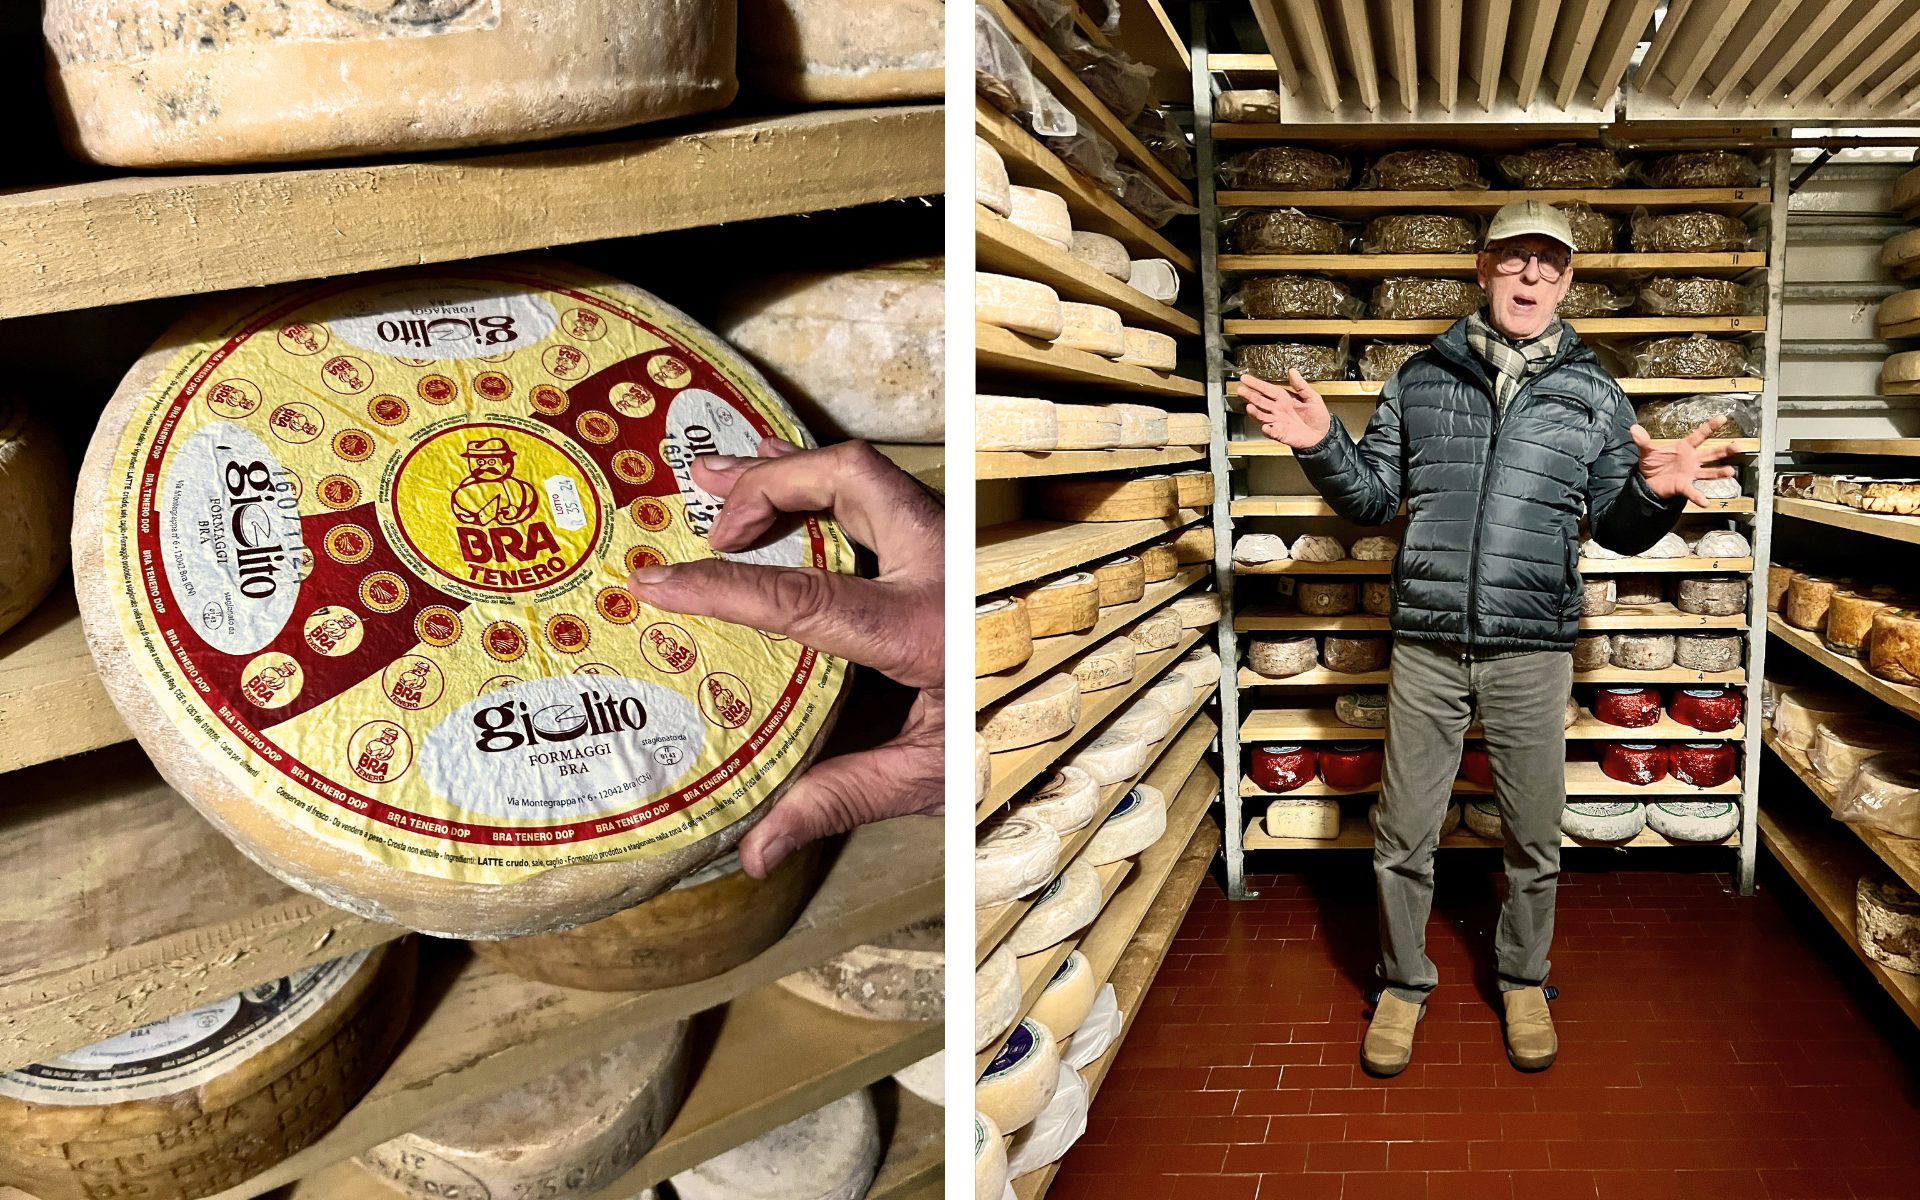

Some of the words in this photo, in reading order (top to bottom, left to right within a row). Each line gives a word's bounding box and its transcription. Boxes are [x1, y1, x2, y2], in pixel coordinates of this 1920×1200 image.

[1734, 190, 1744, 200] 12
[1732, 254, 1739, 265] 11
[376, 315, 519, 348] giolito
[1730, 318, 1740, 329] 10
[328, 358, 354, 377] BRA
[213, 384, 236, 404] BRA
[1731, 378, 1737, 388] 9
[170, 405, 182, 418] BRA
[276, 408, 298, 428] BRA
[157, 418, 175, 445] TENERO
[152, 443, 163, 459] DOP
[144, 473, 155, 487] BRA
[559, 480, 573, 491] 24
[141, 488, 152, 518] TENERO
[551, 493, 564, 515] LOTTO
[1719, 501, 1729, 509] 7
[140, 518, 150, 534] DOP
[198, 520, 210, 545] BRA
[210, 497, 228, 565] FORMAGGI
[225, 460, 285, 599] giolito
[456, 521, 561, 564] BRA
[142, 549, 153, 566] BRA
[1712, 561, 1719, 569] 6
[145, 566, 160, 597] TENERO
[179, 568, 188, 582] Bra
[467, 556, 567, 586] TENERO
[153, 597, 166, 614] DOP
[224, 591, 235, 627] stagionato
[124, 471, 134, 490] LATTE
[173, 688, 187, 702] CEE
[185, 703, 198, 717] 1263
[193, 714, 204, 725] del
[220, 741, 235, 757] Carta
[230, 753, 242, 763] per
[239, 759, 261, 778] alimenti
[228, 626, 235, 635] da
[309, 625, 337, 651] BRA
[165, 628, 179, 647] BRA
[174, 646, 198, 677] TENERO
[194, 675, 211, 694] DOP
[665, 645, 691, 668] BRA
[795, 669, 807, 685] BRA
[1697, 672, 1704, 682] 4
[242, 684, 265, 707] TENERO
[247, 674, 275, 703] BRA
[392, 682, 422, 701] BRA
[389, 693, 419, 709] TENERO
[721, 698, 747, 721] BRA
[473, 690, 648, 753] giolito
[750, 735, 766, 751] BRA
[761, 710, 784, 738] TENERO
[780, 696, 792, 713] DOP
[218, 705, 236, 724] BRA
[234, 719, 264, 751] TENERO
[263, 745, 283, 763] DOP
[641, 735, 677, 747] stagionato
[358, 752, 389, 776] BRA
[528, 743, 612, 767] FORMAGGI
[354, 765, 385, 782] TENERO
[559, 762, 589, 778] BRA
[682, 788, 701, 802] BRA
[698, 769, 728, 792] TENERO
[727, 758, 741, 773] DOP
[290, 765, 310, 783] BRA
[310, 776, 347, 802] TENERO
[347, 796, 369, 812] DOP
[507, 797, 520, 806] Via
[521, 796, 577, 809] Montegrappa
[587, 793, 594, 802] 6
[598, 786, 623, 799] 12042
[623, 780, 637, 791] Bra
[636, 772, 652, 786] (CN)
[276, 786, 306, 810] Conservare
[305, 803, 312, 813] al
[311, 806, 330, 822] fresco
[331, 817, 341, 828] Da
[340, 821, 364, 836] vendere
[368, 832, 384, 845] peso
[386, 839, 407, 851] Crosta
[407, 844, 419, 854] non
[419, 847, 440, 860] edibile
[443, 852, 477, 865] Ingredienti:
[477, 856, 504, 867] LATTE
[505, 858, 531, 868] crudo,
[531, 859, 545, 867] sale,
[545, 858, 564, 869] caglio
[567, 851, 599, 865] Formaggio
[598, 846, 623, 860] prodotto
[627, 837, 656, 851] stagionato
[655, 831, 670, 842] nella
[669, 827, 683, 837] zona
[681, 822, 688, 832] di
[732, 787, 745, 800] CEE
[386, 811, 407, 826] BRA
[409, 818, 449, 836] TENERO
[450, 827, 471, 838] DOP
[595, 822, 615, 833] BRA
[616, 810, 652, 828] TENERO
[653, 802, 670, 816] DOP
[492, 832, 513, 842] BRA
[514, 831, 553, 842] TENERO
[555, 829, 575, 841] DOP
[130, 1029, 151, 1038] BRA
